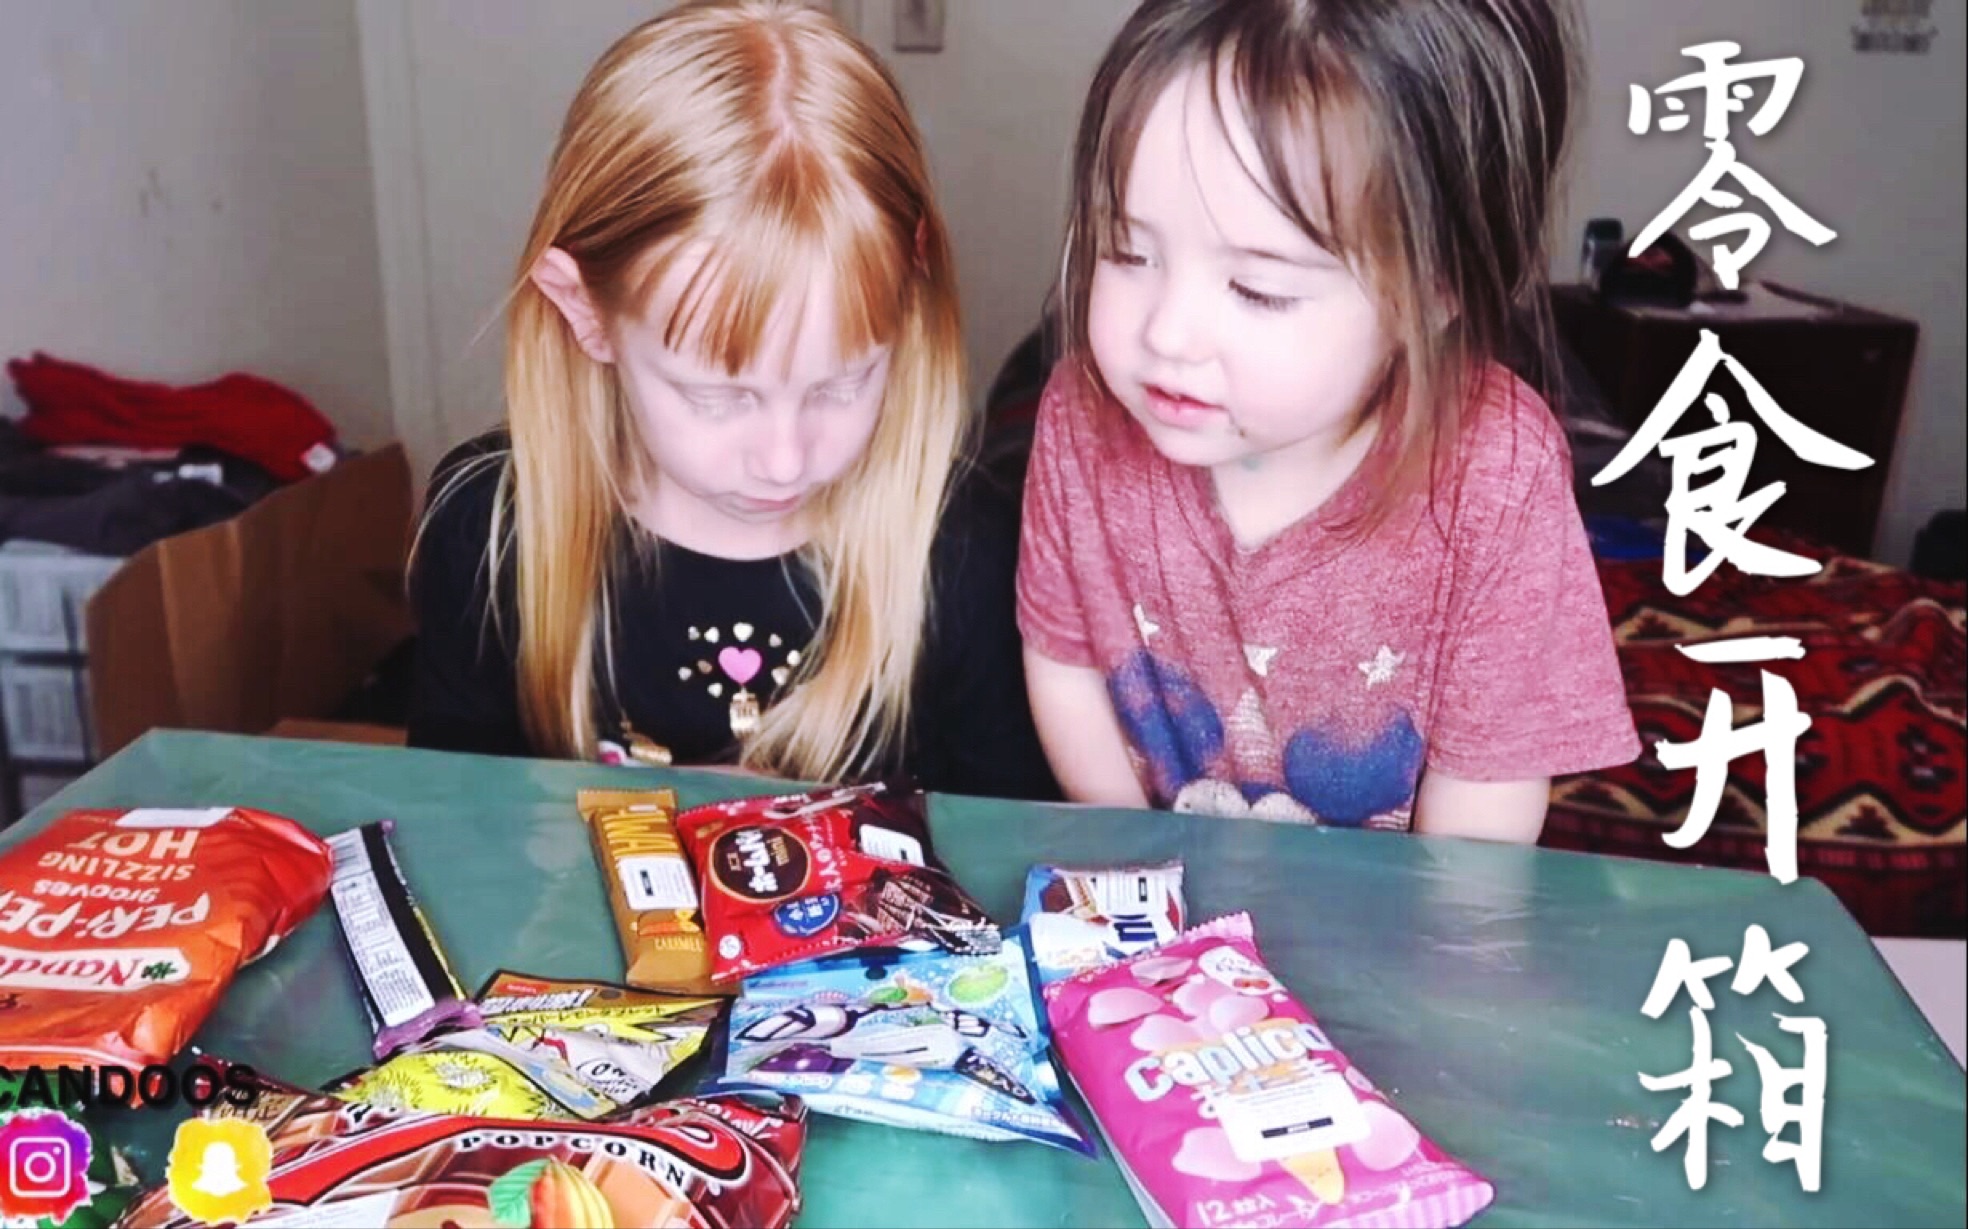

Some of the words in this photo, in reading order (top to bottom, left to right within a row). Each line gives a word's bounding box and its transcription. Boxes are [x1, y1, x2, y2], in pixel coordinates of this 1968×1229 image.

[64, 828, 200, 860] HOT
[37, 851, 196, 882] SIZZLING
[34, 879, 161, 904] grooves
[1123, 1018, 1332, 1103] Caplico
[460, 1132, 688, 1187] POPCORN
